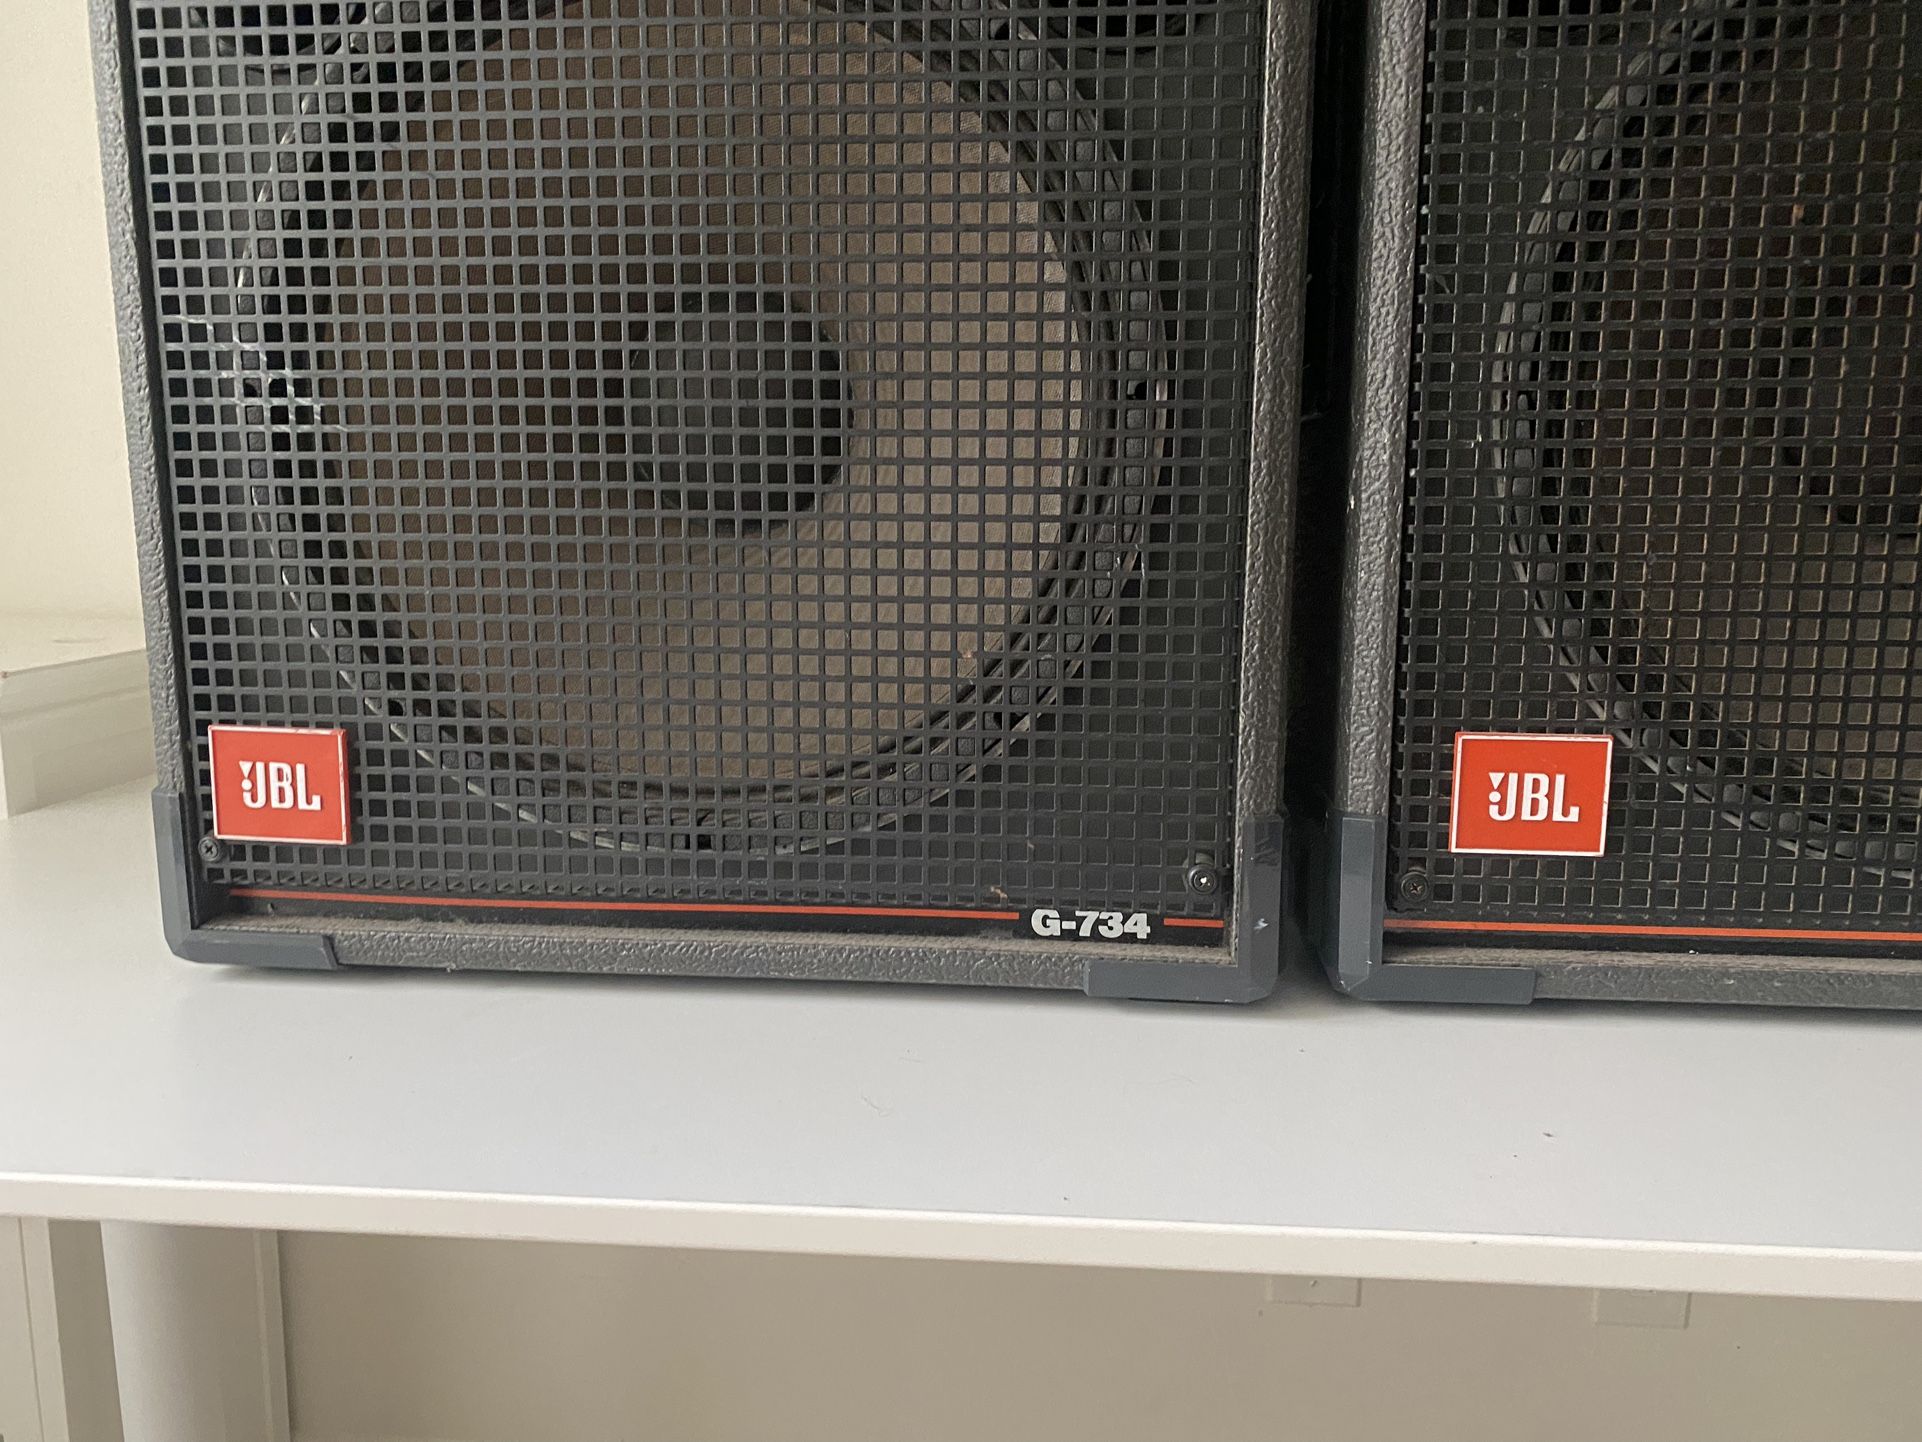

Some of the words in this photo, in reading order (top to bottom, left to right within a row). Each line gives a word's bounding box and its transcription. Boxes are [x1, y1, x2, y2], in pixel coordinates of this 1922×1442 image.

[239, 760, 322, 811] JBL
[1488, 771, 1580, 822] JBL
[1031, 908, 1151, 940] G-734
